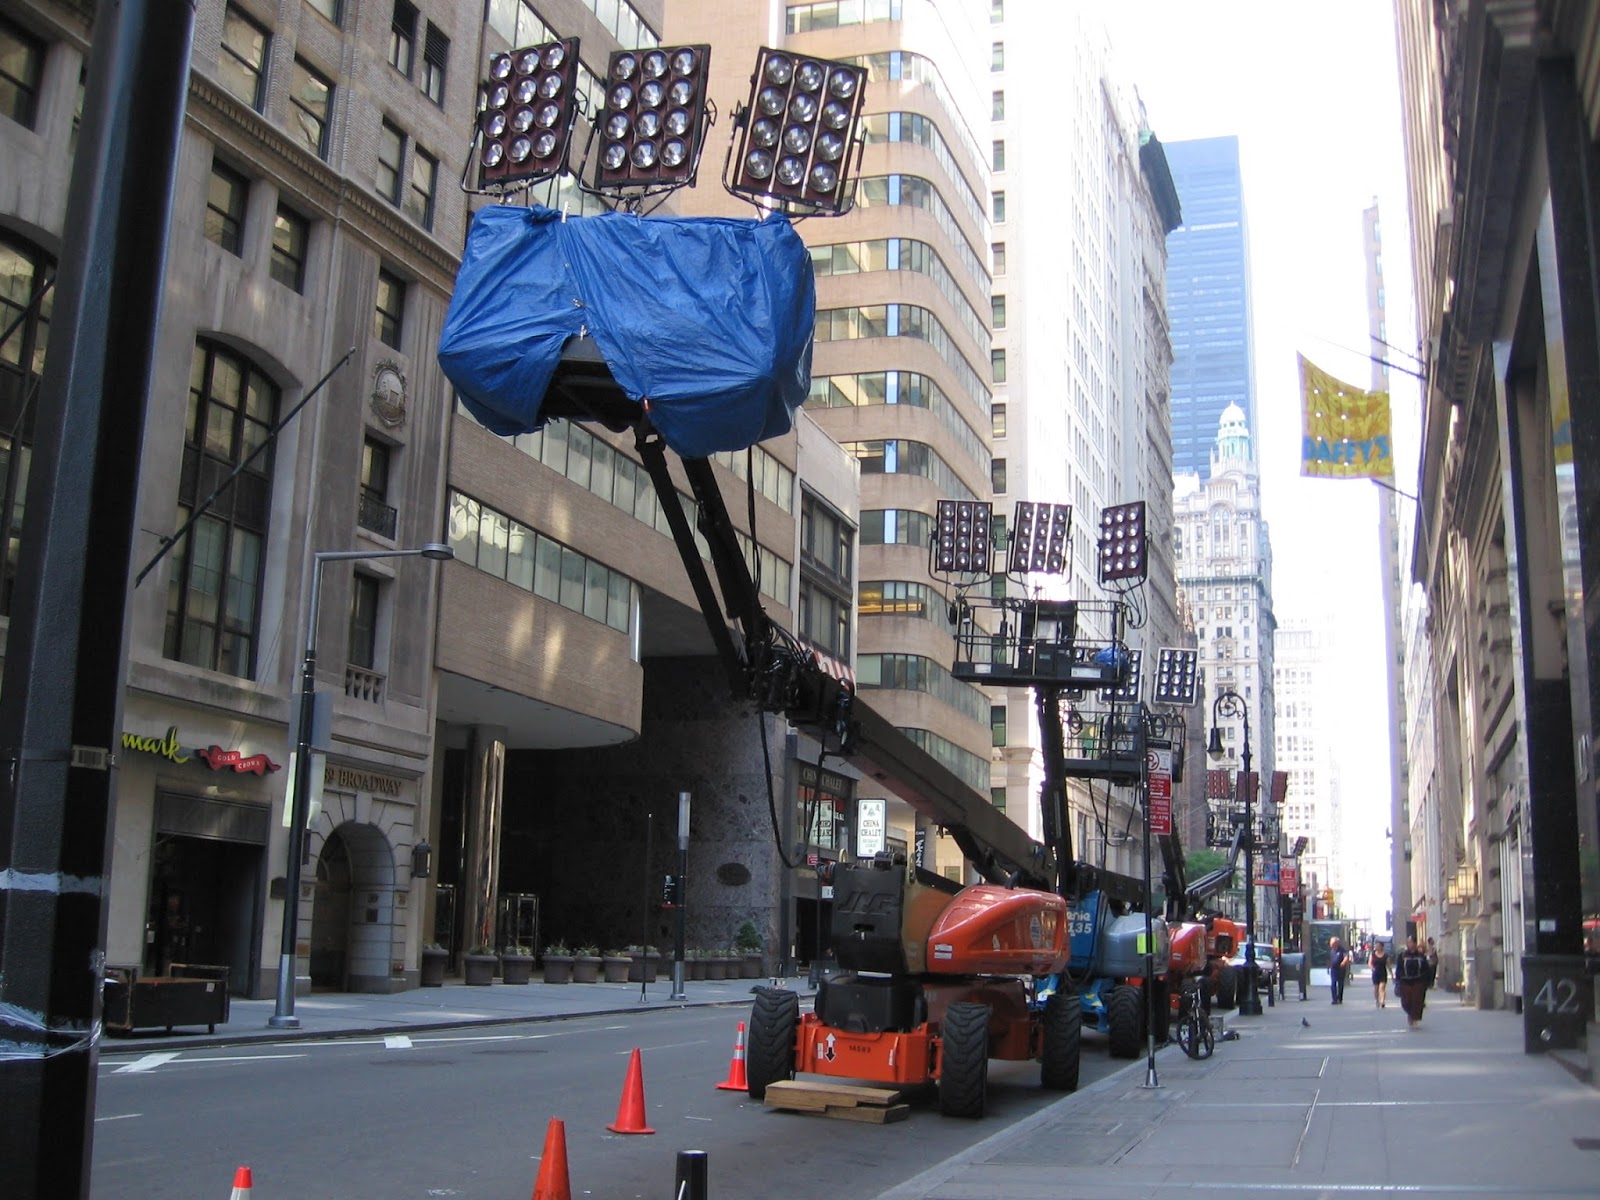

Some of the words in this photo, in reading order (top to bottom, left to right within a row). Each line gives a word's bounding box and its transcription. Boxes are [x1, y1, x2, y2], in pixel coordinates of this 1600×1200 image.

[339, 768, 402, 796] BROADWAY
[863, 820, 880, 828] CHINA
[861, 829, 882, 837] CHALET
[1067, 910, 1090, 921] enie
[1534, 978, 1579, 1014] 42
